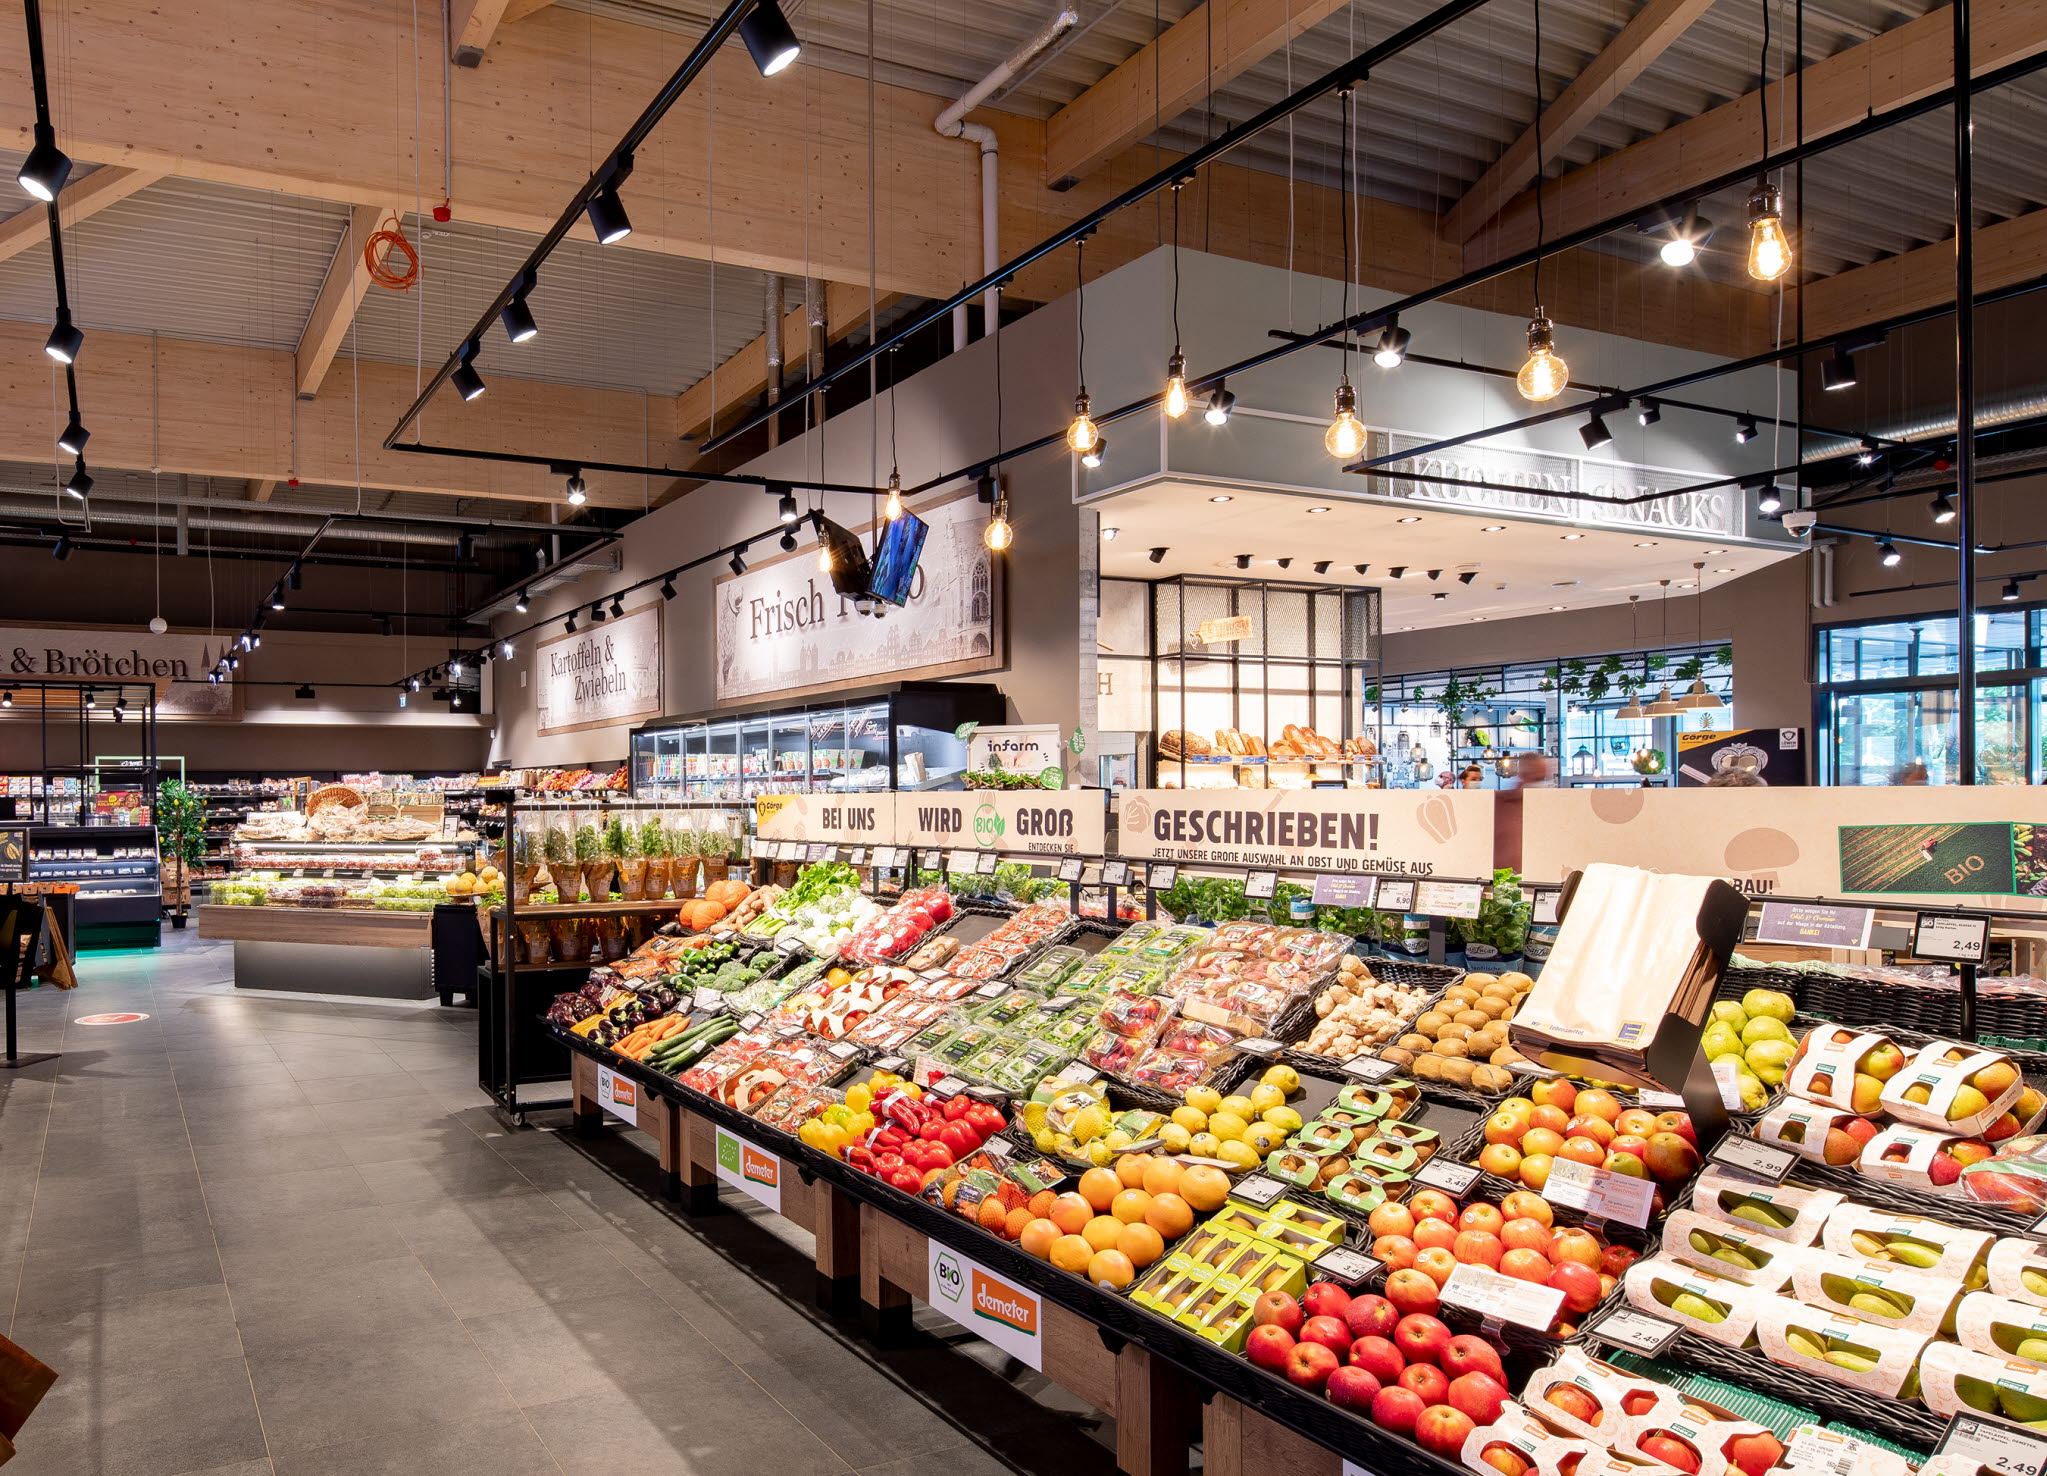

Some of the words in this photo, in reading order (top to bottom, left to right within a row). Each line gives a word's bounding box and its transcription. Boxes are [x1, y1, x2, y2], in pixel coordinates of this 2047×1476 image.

[750, 578, 824, 640] Frisch
[10, 647, 36, 673] &
[43, 649, 188, 678] Brötchen
[551, 638, 602, 678] Kartoffeln
[605, 635, 614, 663] &
[574, 664, 627, 701] Zwiebeln
[987, 739, 1039, 752] infarm
[1682, 733, 1717, 741] Görge
[822, 807, 842, 830] BEI
[847, 807, 875, 831] UNS
[918, 807, 962, 833] WIRD
[976, 816, 994, 834] BIO
[1154, 809, 1379, 851] GESCHRIEBEN!
[1028, 841, 1063, 852] ENTDECKEN
[1064, 843, 1074, 853] SIE
[1152, 848, 1175, 858] JETZT
[1177, 849, 1208, 861] UNSERE
[1242, 852, 1287, 866] AUSWAHL
[1289, 854, 1304, 867] AN
[1308, 856, 1332, 869] OBST
[1336, 857, 1358, 870] UND
[1362, 858, 1406, 873] GEMÜSE
[1410, 862, 1433, 875] AUS
[1944, 854, 1985, 885] BIO
[1953, 940, 1981, 951] 2,49
[614, 1083, 633, 1101] demeter
[745, 1154, 774, 1179] demeter
[1752, 1159, 1782, 1173] 2,99
[1445, 1177, 1467, 1188] 3,49
[1255, 1190, 1272, 1199] 3,49
[1343, 1265, 1364, 1276] 3,49
[977, 1283, 1029, 1323] demeter
[1631, 1331, 1660, 1344] 2,49
[1995, 1456, 2038, 1476] 2,49
